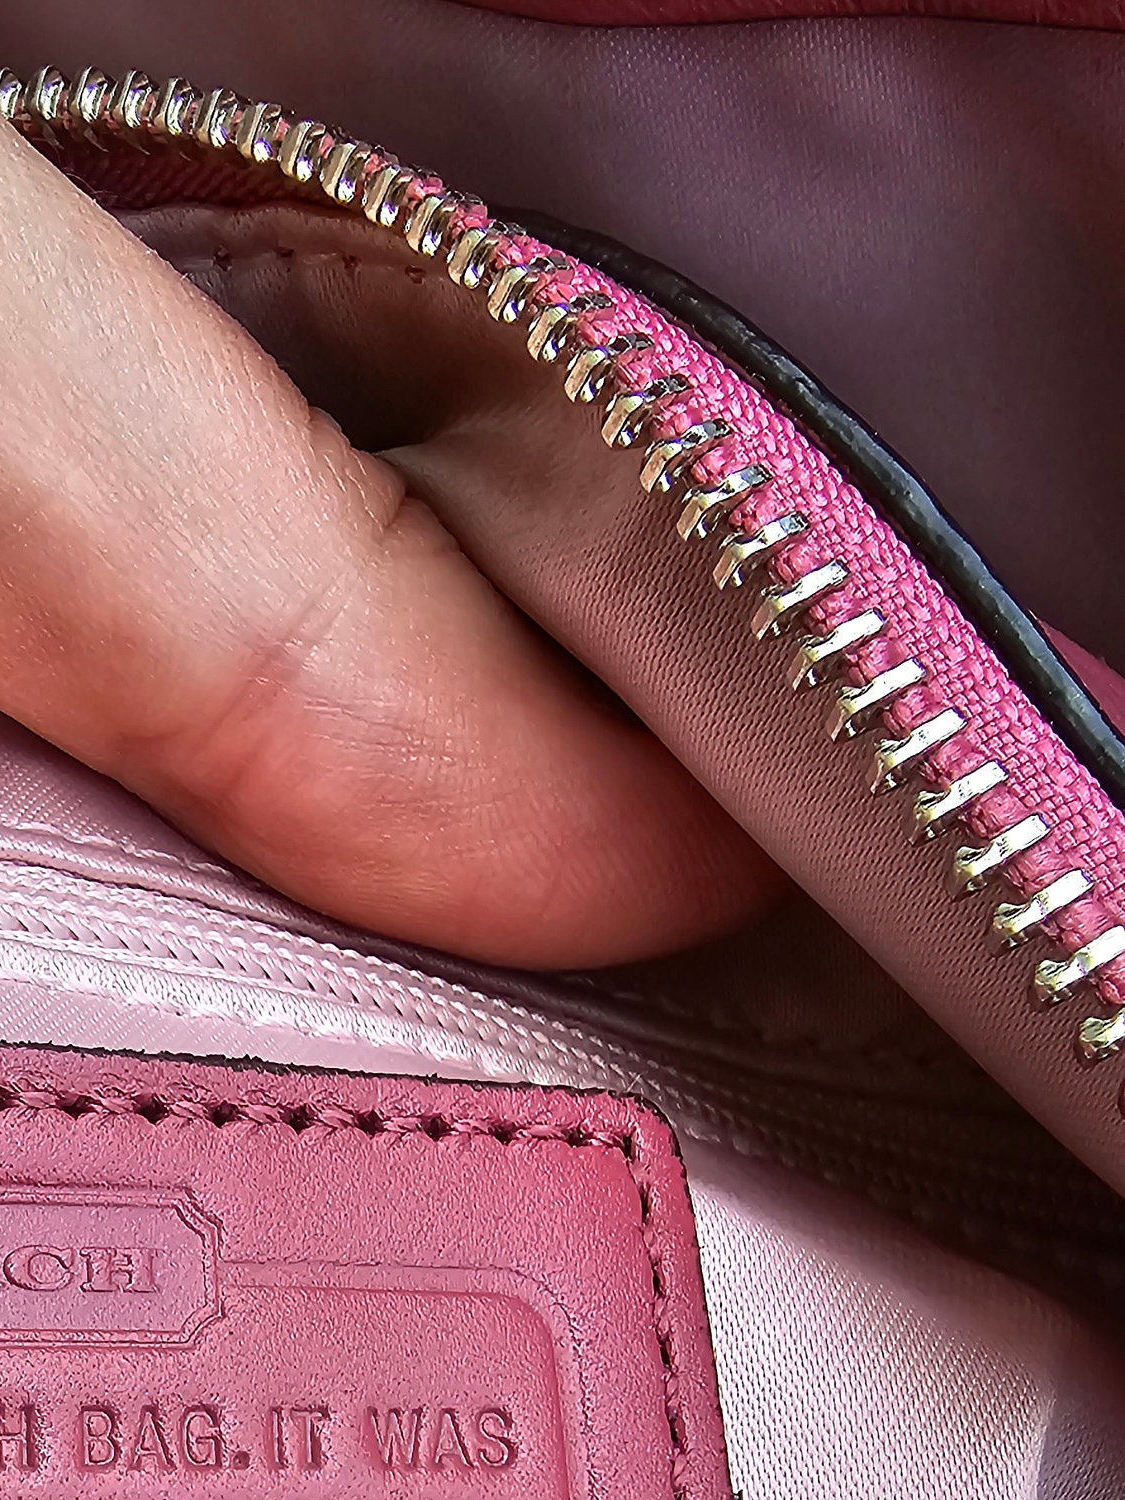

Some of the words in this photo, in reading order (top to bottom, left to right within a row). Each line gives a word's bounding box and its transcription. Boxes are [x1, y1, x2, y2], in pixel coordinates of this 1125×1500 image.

[77, 1402, 253, 1472] BAG.
[267, 1404, 331, 1471] IT
[366, 1403, 521, 1470] WAS
